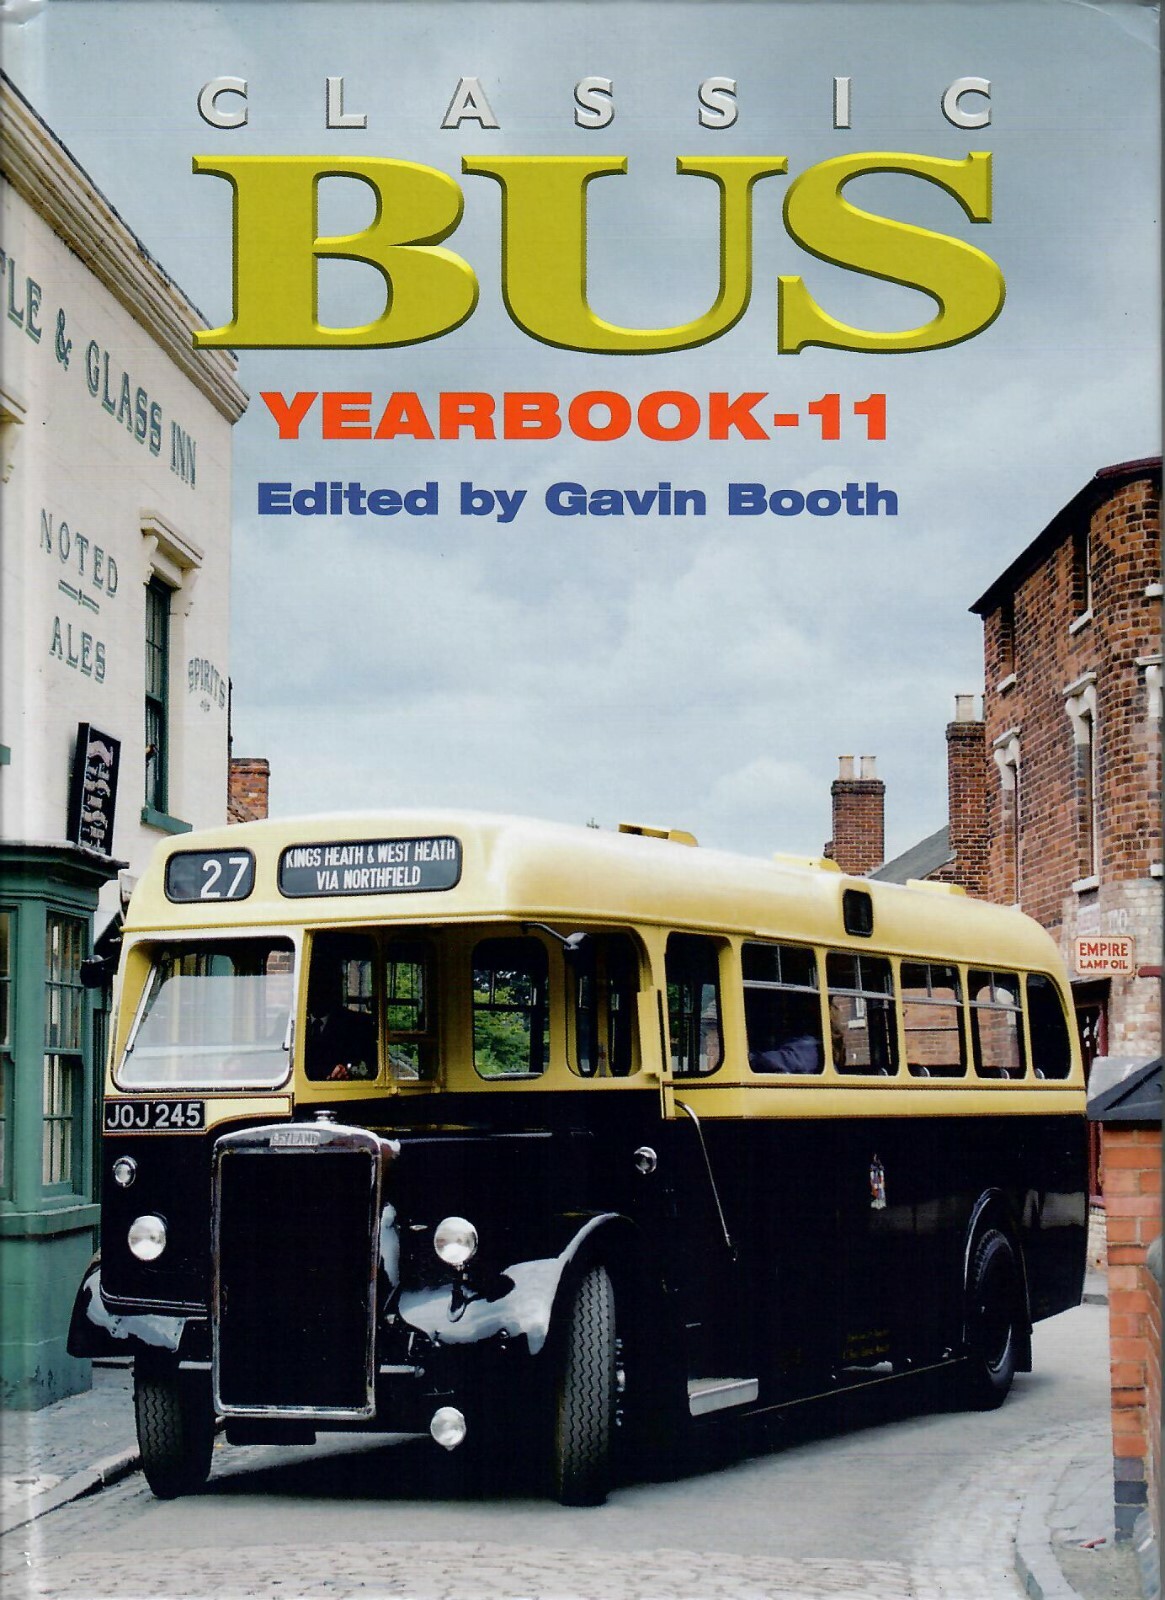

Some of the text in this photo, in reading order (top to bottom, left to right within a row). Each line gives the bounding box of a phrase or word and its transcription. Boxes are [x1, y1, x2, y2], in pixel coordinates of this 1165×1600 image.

[55, 308, 72, 371] &
[86, 340, 162, 457] GLASS
[170, 420, 197, 490] INN
[40, 508, 119, 598] NOTED
[49, 616, 106, 684] ALES
[188, 657, 226, 710] SPIRITS
[285, 840, 456, 869] KINGS HEATH & WEST HEATH
[200, 857, 250, 899] 27
[316, 866, 421, 891] VIA NORTHFIELD
[1080, 942, 1129, 957] EMPIRE
[1080, 959, 1128, 969] LAMP OIL
[107, 1102, 201, 1128] JOJ 245
[272, 1131, 318, 1145] LEYLAND
